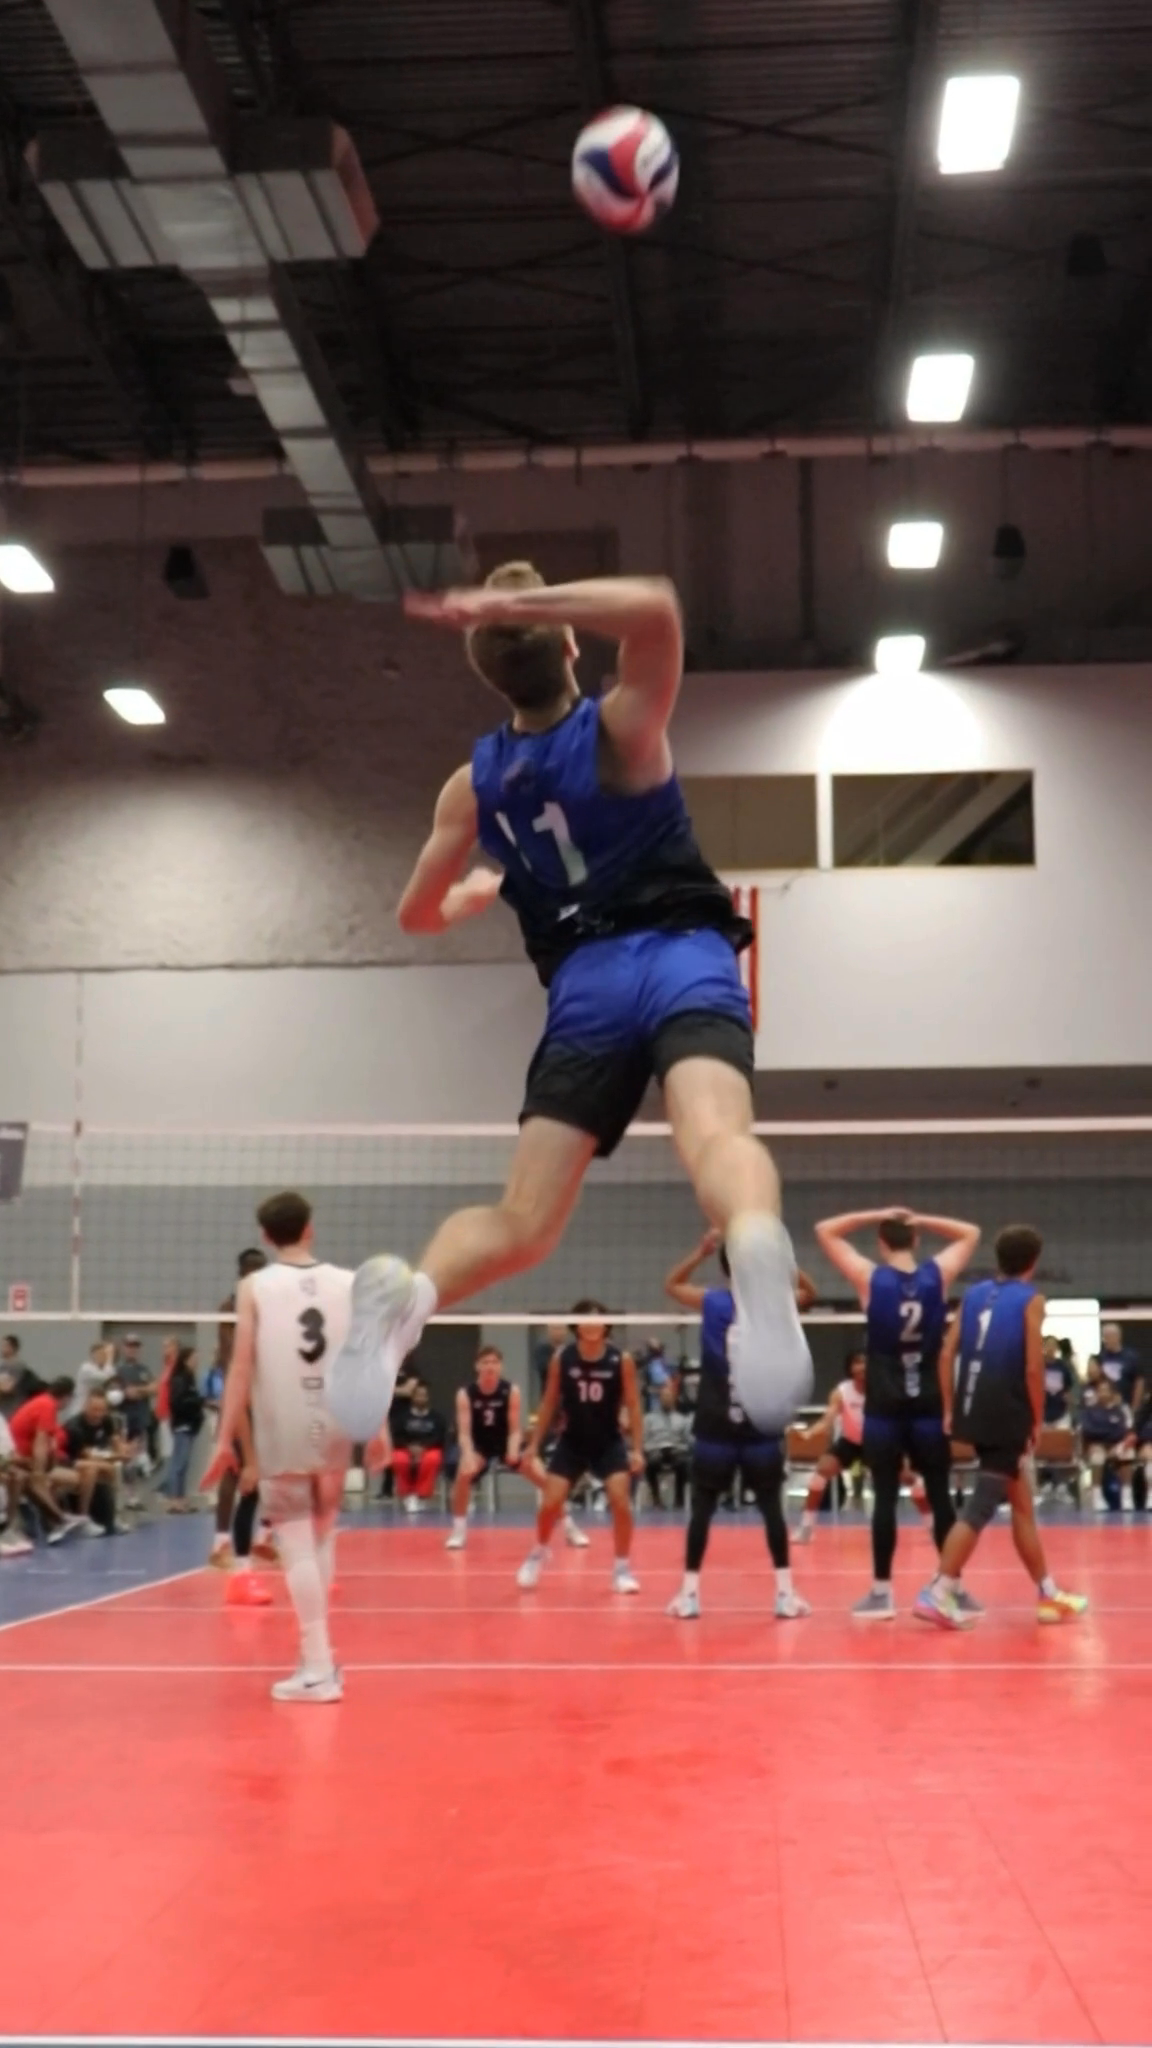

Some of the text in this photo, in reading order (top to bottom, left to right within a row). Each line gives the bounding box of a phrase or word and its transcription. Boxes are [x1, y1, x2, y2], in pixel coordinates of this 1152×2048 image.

[297, 1307, 327, 1364] 3
[899, 1301, 923, 1342] 2
[976, 1308, 993, 1351] 1
[577, 1381, 604, 1402] 10
